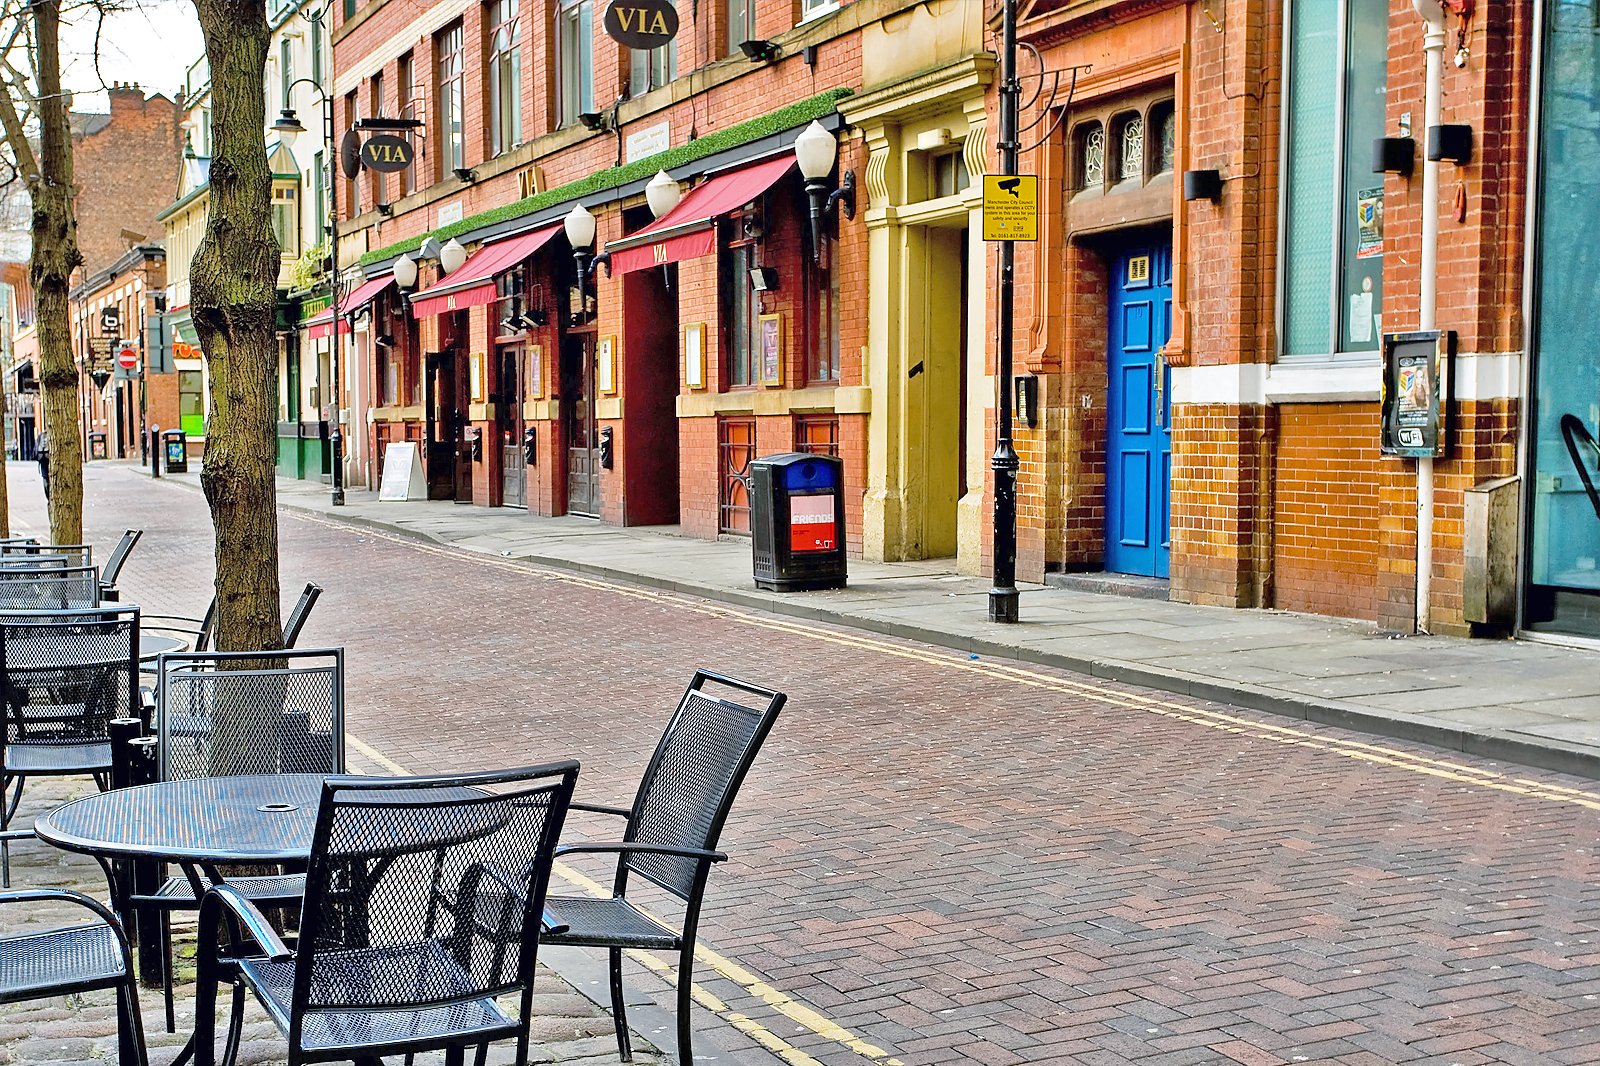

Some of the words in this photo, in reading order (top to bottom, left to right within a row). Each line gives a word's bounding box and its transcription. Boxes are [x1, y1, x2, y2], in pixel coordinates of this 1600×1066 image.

[614, 7, 669, 35] VIA
[368, 144, 407, 163] VIA
[516, 166, 542, 200] VIA
[653, 243, 668, 263] VIA
[792, 514, 832, 524] FRIENDS
